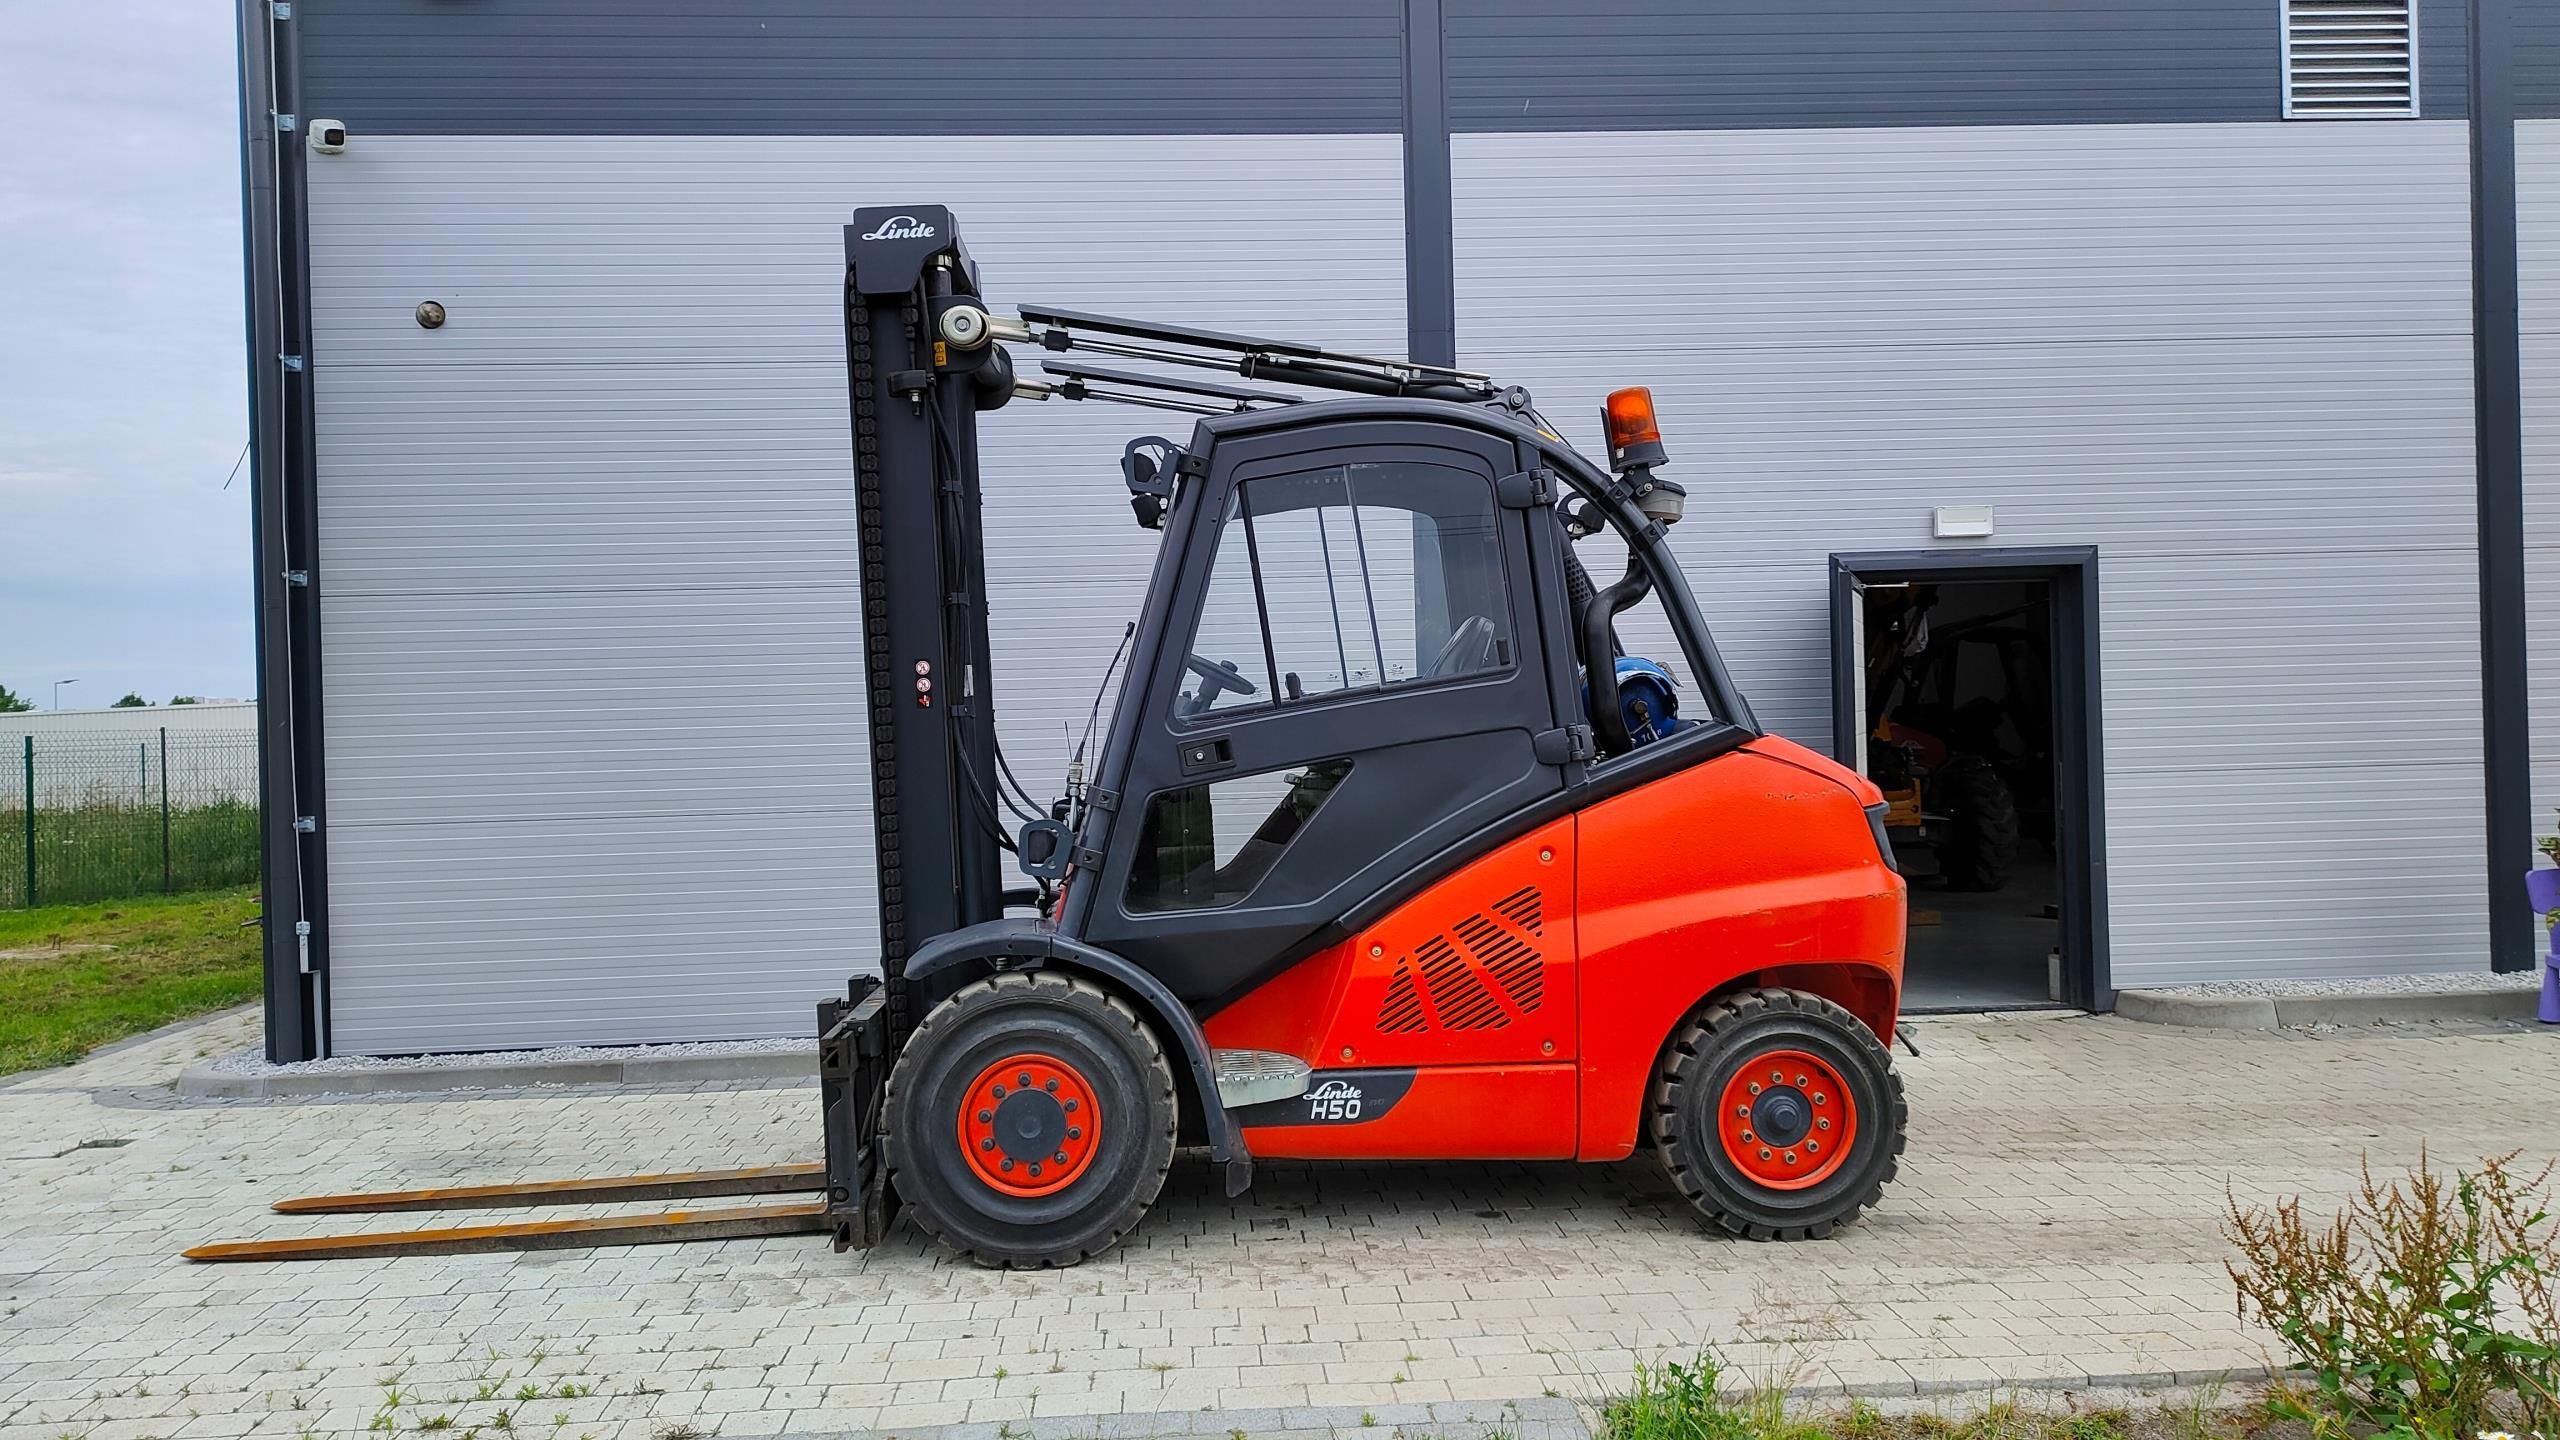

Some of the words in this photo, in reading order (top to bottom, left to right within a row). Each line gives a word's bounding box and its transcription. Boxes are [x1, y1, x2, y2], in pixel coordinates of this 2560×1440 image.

[861, 215, 935, 241] Linde
[1302, 1080, 1362, 1100] Linde
[1310, 1099, 1361, 1120] H50
